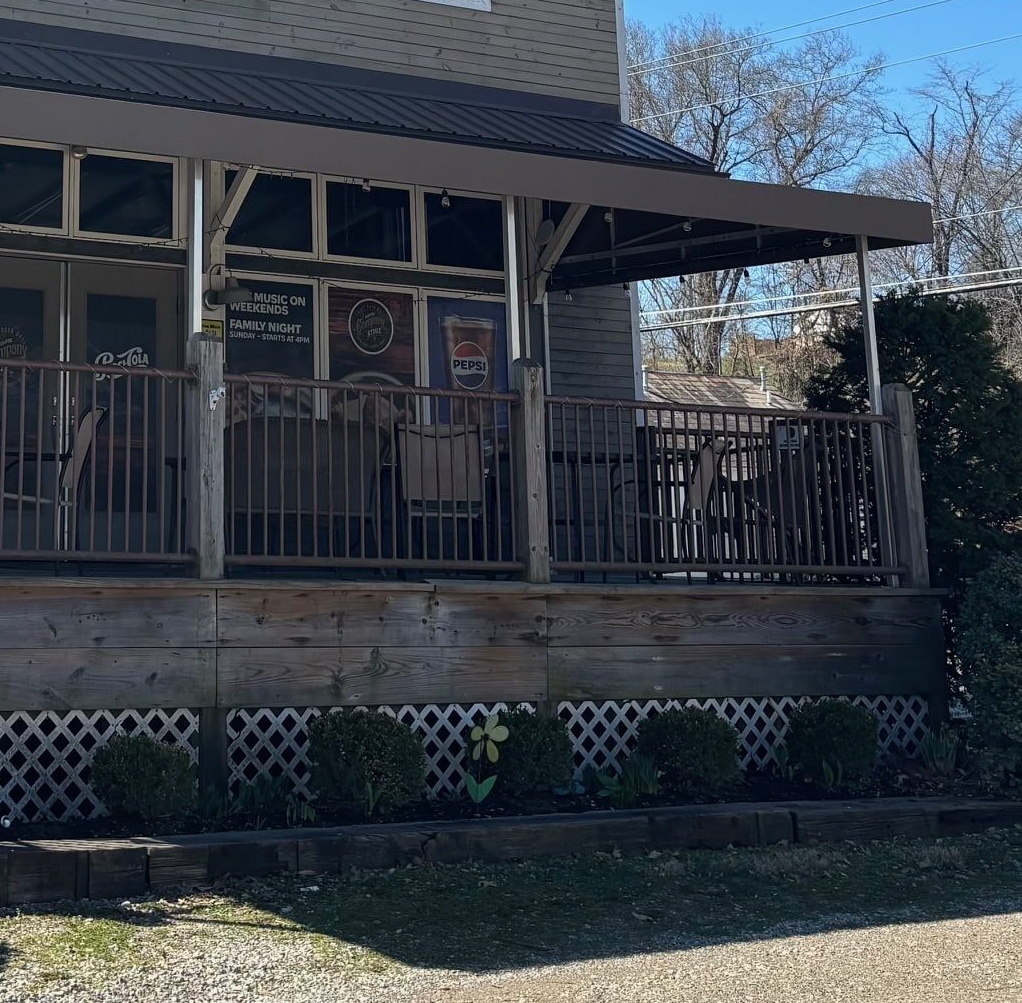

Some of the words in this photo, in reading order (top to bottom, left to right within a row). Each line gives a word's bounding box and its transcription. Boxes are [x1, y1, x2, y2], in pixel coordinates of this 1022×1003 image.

[253, 292, 288, 305] MUSIC
[289, 296, 306, 307] ON
[230, 302, 289, 316] WEEKENDS
[229, 318, 267, 331] FAMILY
[268, 322, 302, 334] NIGHT
[229, 331, 256, 340] SUNDAY
[261, 333, 286, 342] STARTS
[286, 335, 295, 343] AT
[295, 336, 310, 344] 4PM
[453, 359, 486, 372] PEPSI
